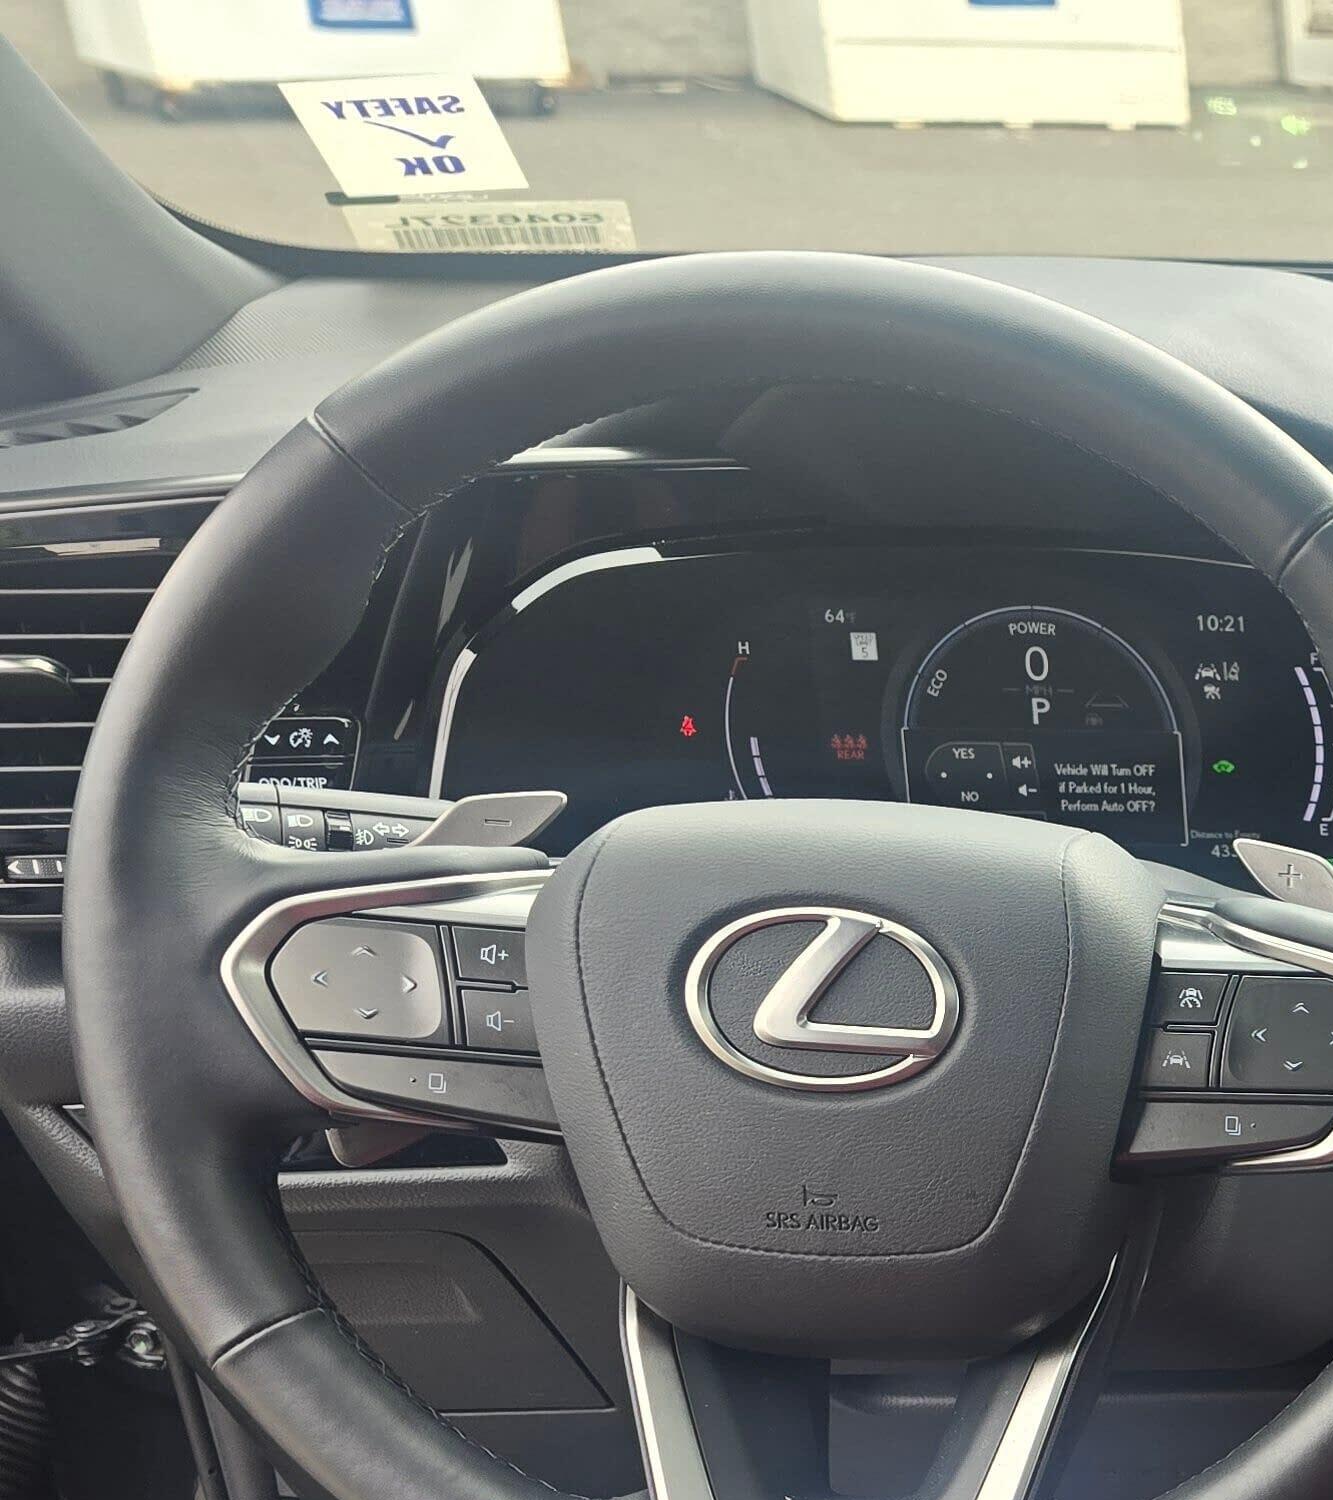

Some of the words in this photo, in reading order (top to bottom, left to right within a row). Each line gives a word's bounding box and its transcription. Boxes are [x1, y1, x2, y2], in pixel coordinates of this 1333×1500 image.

[1008, 622, 1056, 637] POWER
[1197, 614, 1244, 633] 10:21
[738, 641, 750, 655] H
[1024, 646, 1049, 681] 0
[1310, 652, 1319, 665] F
[926, 668, 948, 697] ECO
[1031, 697, 1051, 725] P
[836, 750, 864, 760] REAR
[952, 748, 975, 759] YES
[1054, 763, 1088, 776] Vehicle
[1090, 764, 1109, 776] Will
[1111, 764, 1132, 776] Turn
[1133, 764, 1156, 777] OFF
[1068, 781, 1101, 794] Parked
[1103, 782, 1118, 794] for
[1128, 783, 1156, 796] Hour,
[961, 791, 980, 802] NO
[1061, 799, 1099, 812] Perform
[1101, 800, 1125, 812] Auto
[1126, 800, 1156, 813] OFF?
[1320, 823, 1329, 836] E
[1210, 844, 1237, 858] 43
[766, 1212, 801, 1231] SRS
[806, 1213, 879, 1234] AIRBAG
